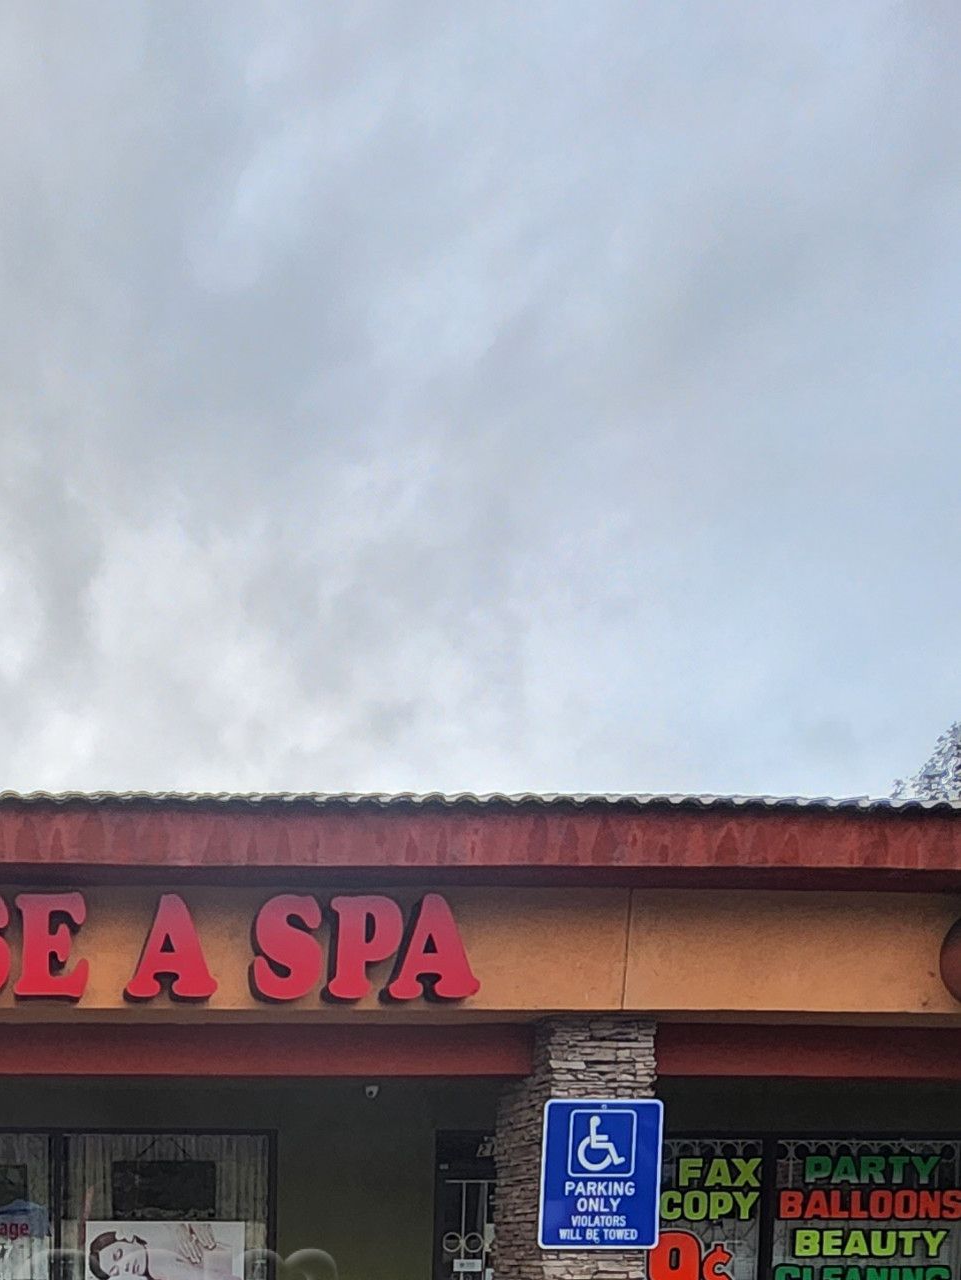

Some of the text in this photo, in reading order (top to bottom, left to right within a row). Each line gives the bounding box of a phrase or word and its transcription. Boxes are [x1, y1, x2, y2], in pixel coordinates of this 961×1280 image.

[126, 892, 218, 999] A
[252, 893, 481, 1000] SPA
[679, 1157, 762, 1188] FAX
[804, 1155, 941, 1185] PARTY
[564, 1181, 635, 1196] PARKING
[576, 1197, 621, 1213] ONLY
[660, 1190, 760, 1220] COPY
[779, 1189, 961, 1219] BALLOONS
[558, 1228, 638, 1240] WILL BE TOWED
[570, 1215, 627, 1227] VIOLATORS
[794, 1229, 948, 1257] BEAUTY
